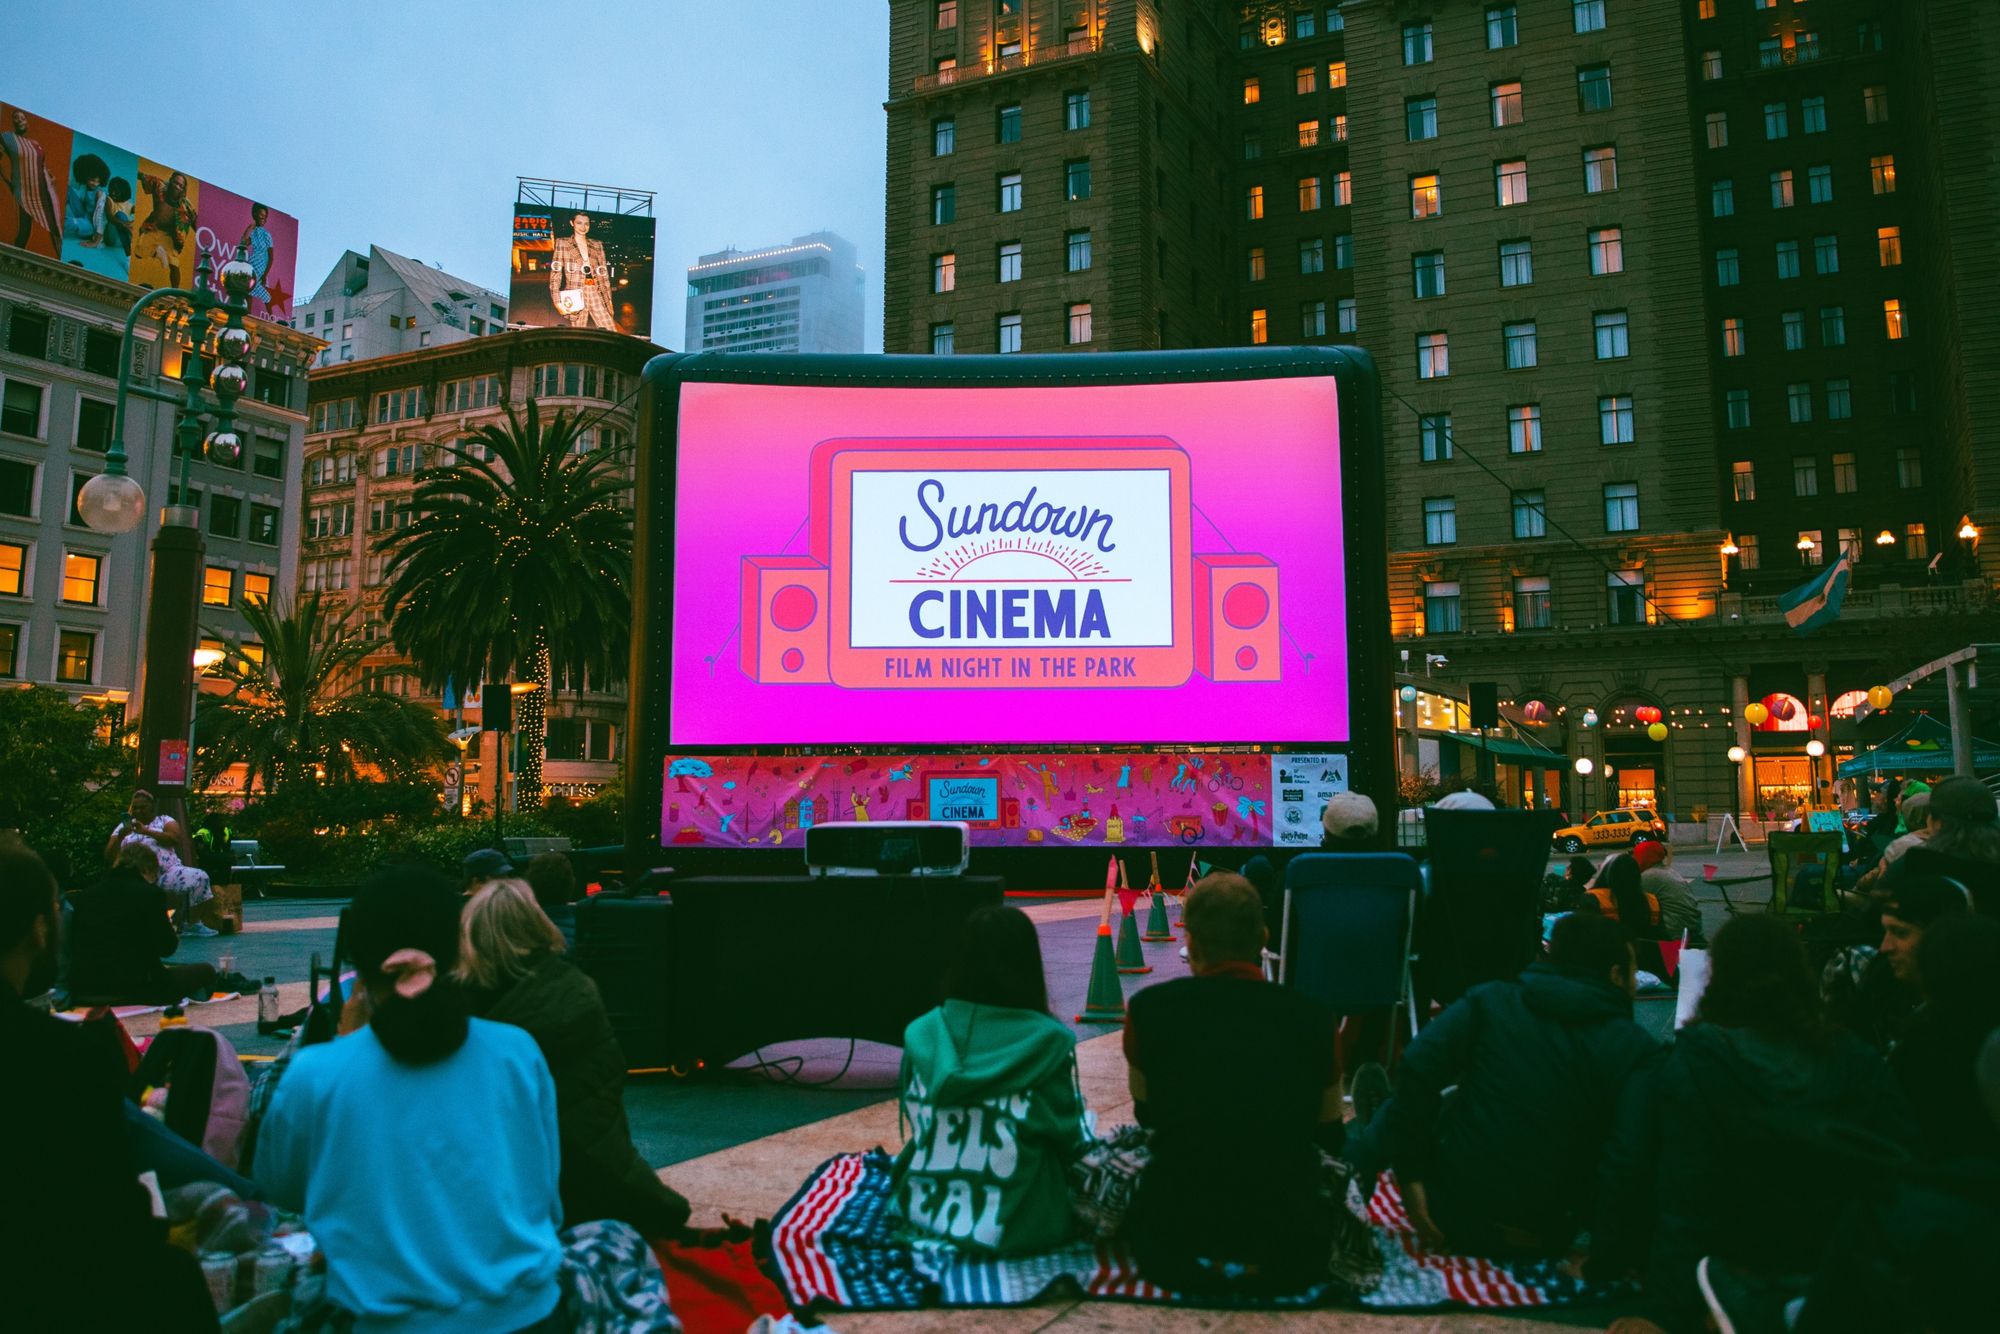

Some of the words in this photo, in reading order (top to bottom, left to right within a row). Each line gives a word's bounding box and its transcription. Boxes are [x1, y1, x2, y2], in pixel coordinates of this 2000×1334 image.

[514, 216, 547, 224] RADIO
[551, 260, 615, 278] GUCCI
[899, 479, 1116, 552] Sundown
[909, 589, 1112, 639] CINEMA
[885, 657, 933, 678] FILM
[942, 657, 1003, 678] NIGHT
[1011, 657, 1032, 678] IN
[1040, 657, 1078, 678] THE
[1086, 656, 1137, 678] PARK
[542, 785, 596, 797] XPRESS
[939, 780, 986, 799] Sundown
[942, 806, 985, 818] CINEMA
[908, 1176, 1004, 1249] EAL
